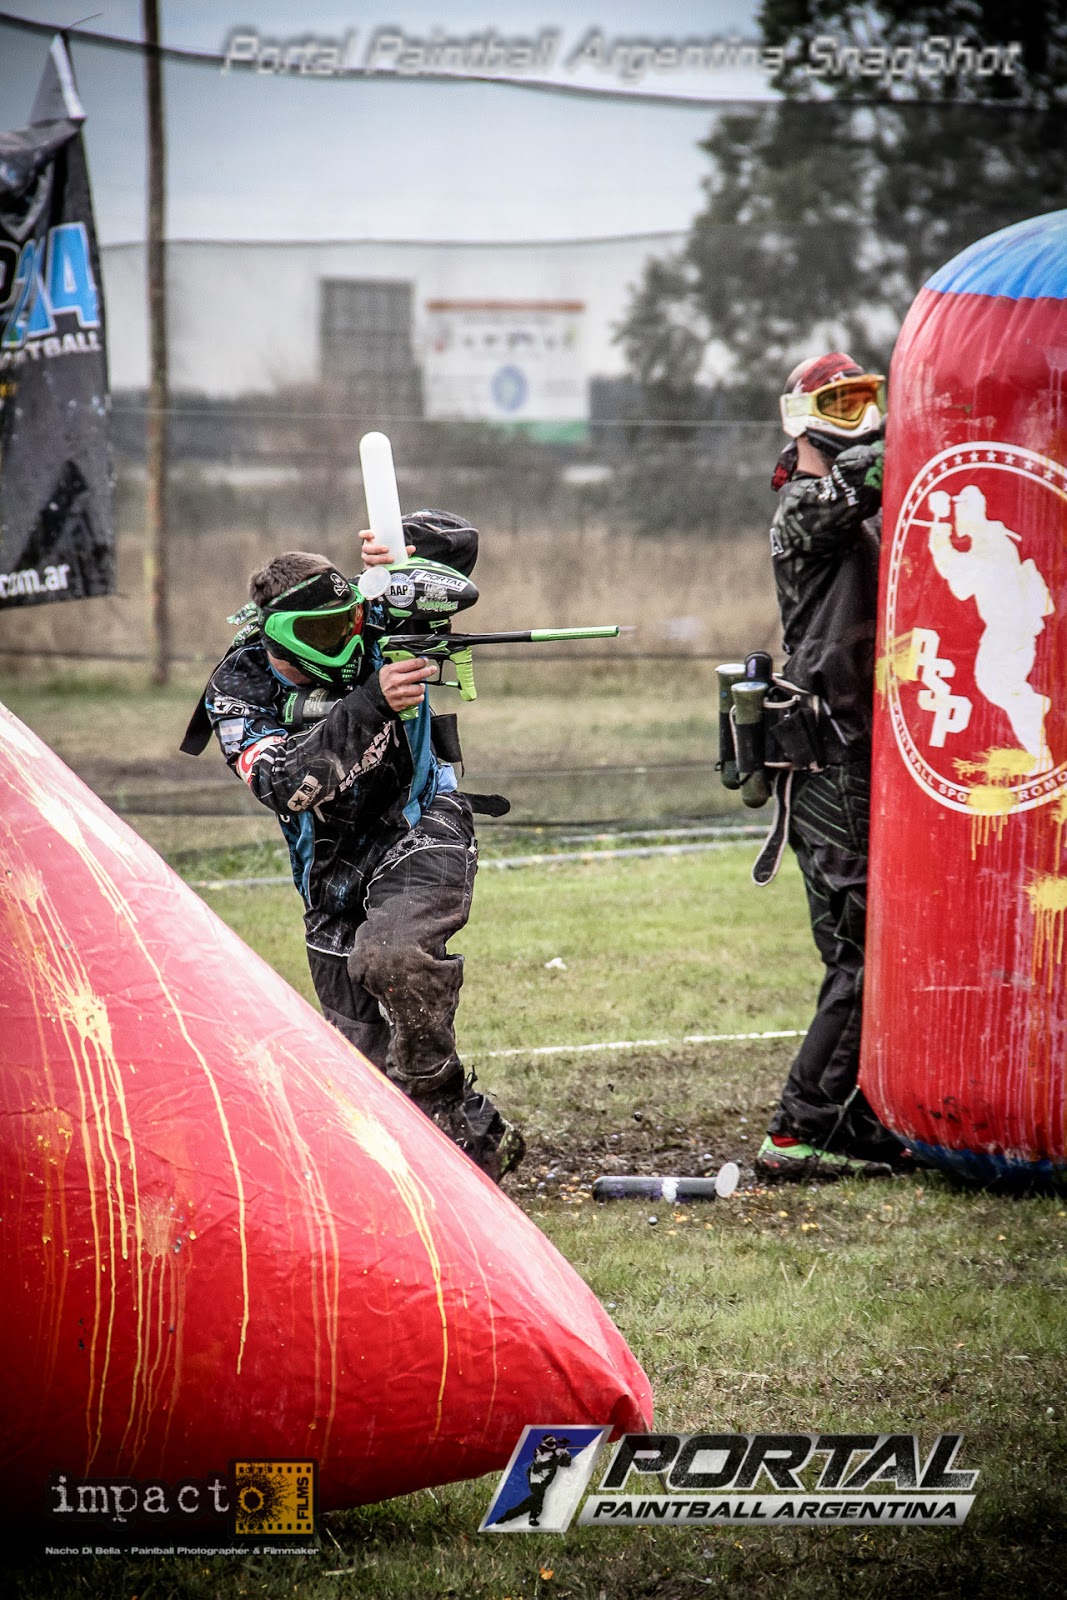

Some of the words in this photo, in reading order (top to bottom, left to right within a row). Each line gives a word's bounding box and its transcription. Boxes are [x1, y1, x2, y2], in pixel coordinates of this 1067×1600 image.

[422, 573, 463, 587] PORTAL
[390, 585, 408, 596] AAP
[1012, 770, 1067, 803] ROMO
